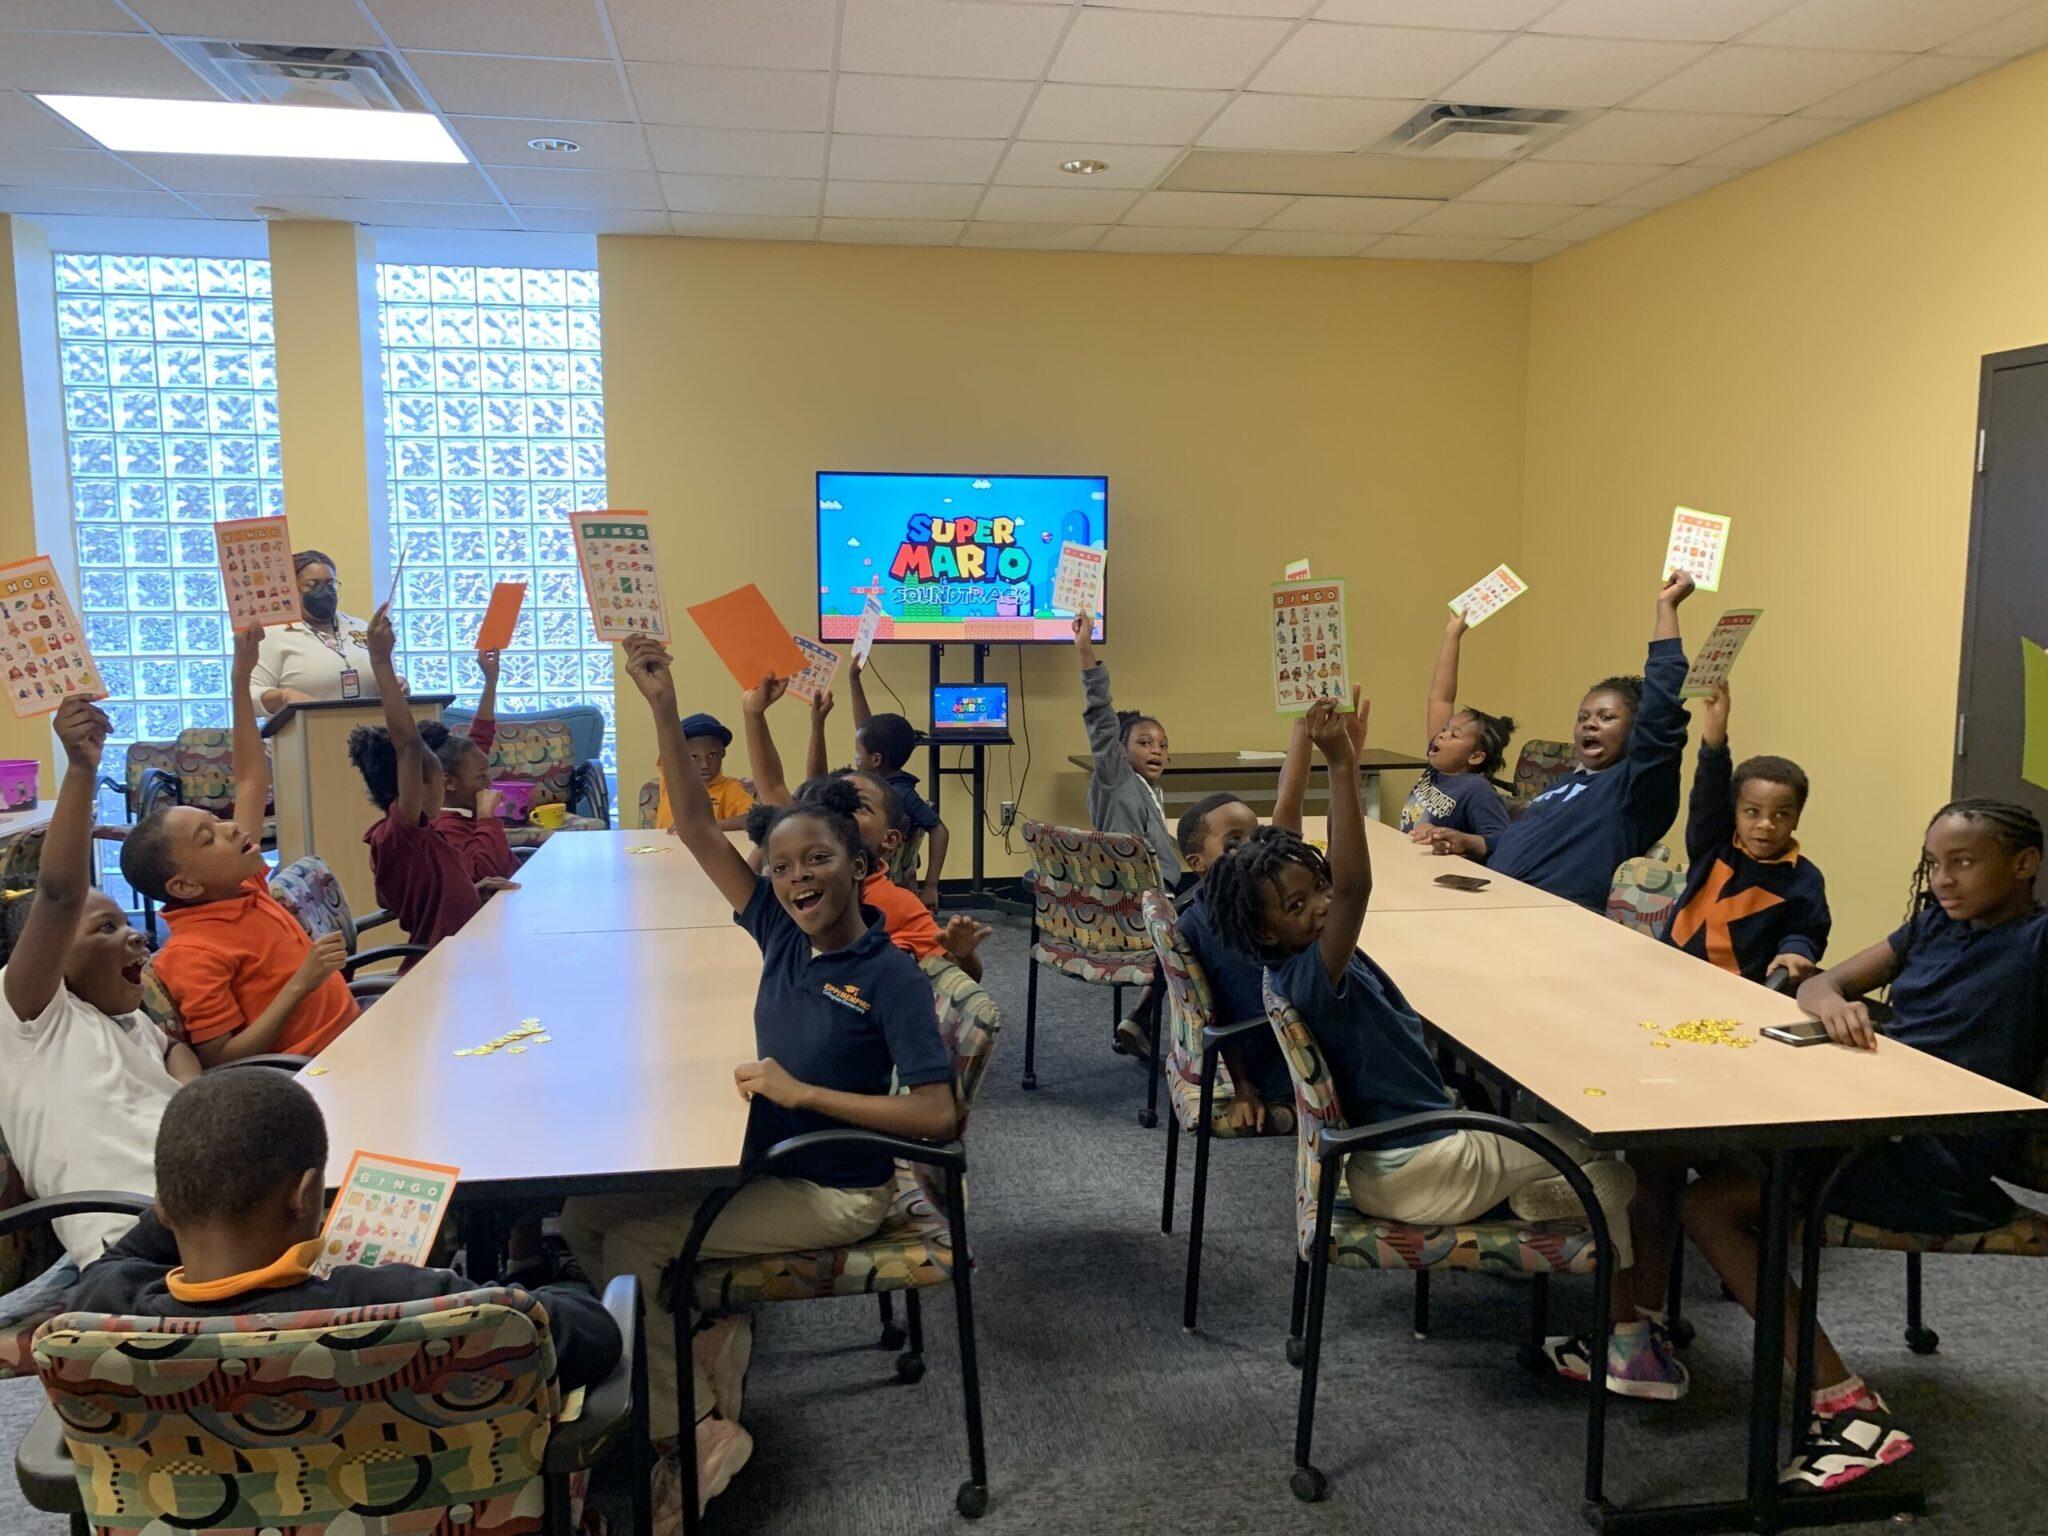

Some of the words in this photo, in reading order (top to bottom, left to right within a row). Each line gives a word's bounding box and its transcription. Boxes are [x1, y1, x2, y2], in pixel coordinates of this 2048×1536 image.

[906, 513, 1016, 546] SUPER
[889, 542, 1032, 584] MARIO
[6, 575, 50, 593] NGO
[890, 585, 1031, 606] SOUNDTRACK
[1276, 591, 1336, 605] BINGO
[1671, 858, 1786, 976] K
[359, 1172, 438, 1197] BINGO
